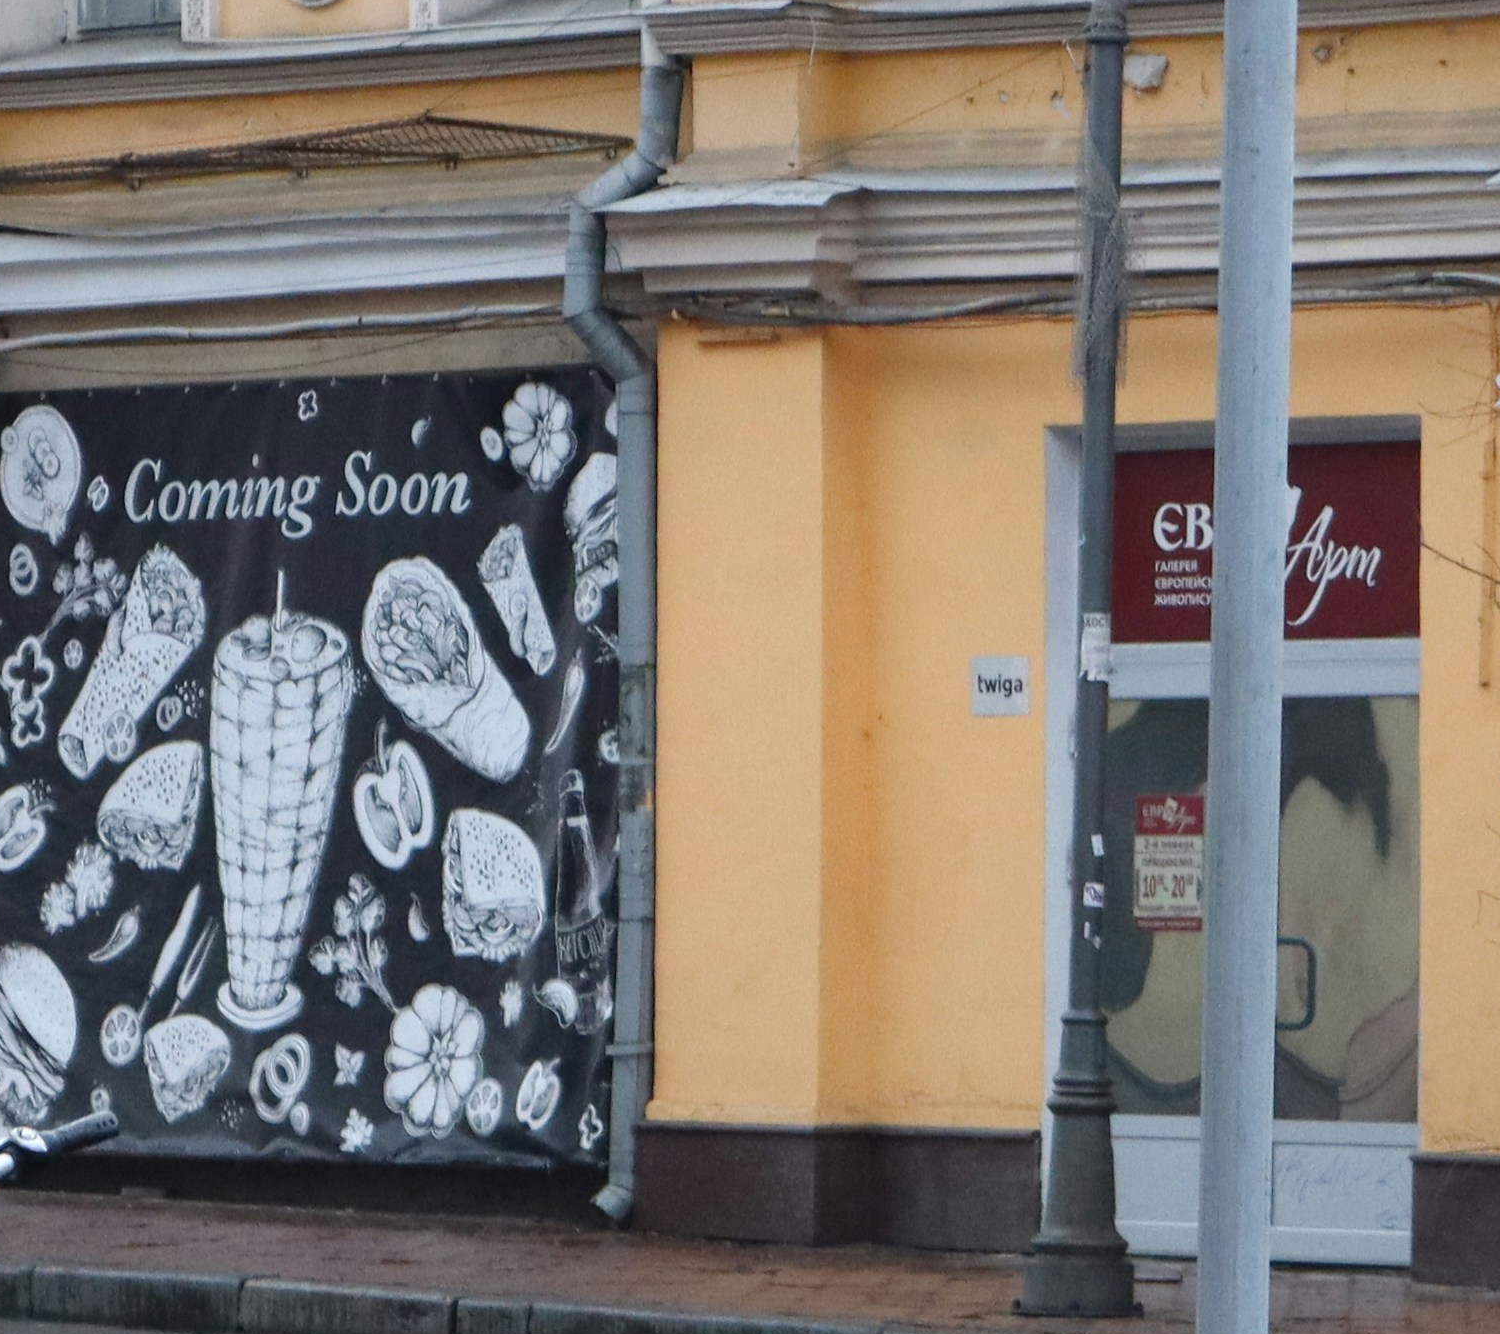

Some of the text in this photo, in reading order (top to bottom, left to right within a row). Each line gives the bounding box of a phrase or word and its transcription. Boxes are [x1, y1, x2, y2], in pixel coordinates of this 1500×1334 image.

[124, 450, 471, 539] Coming Soon
[977, 673, 1023, 698] twiga
